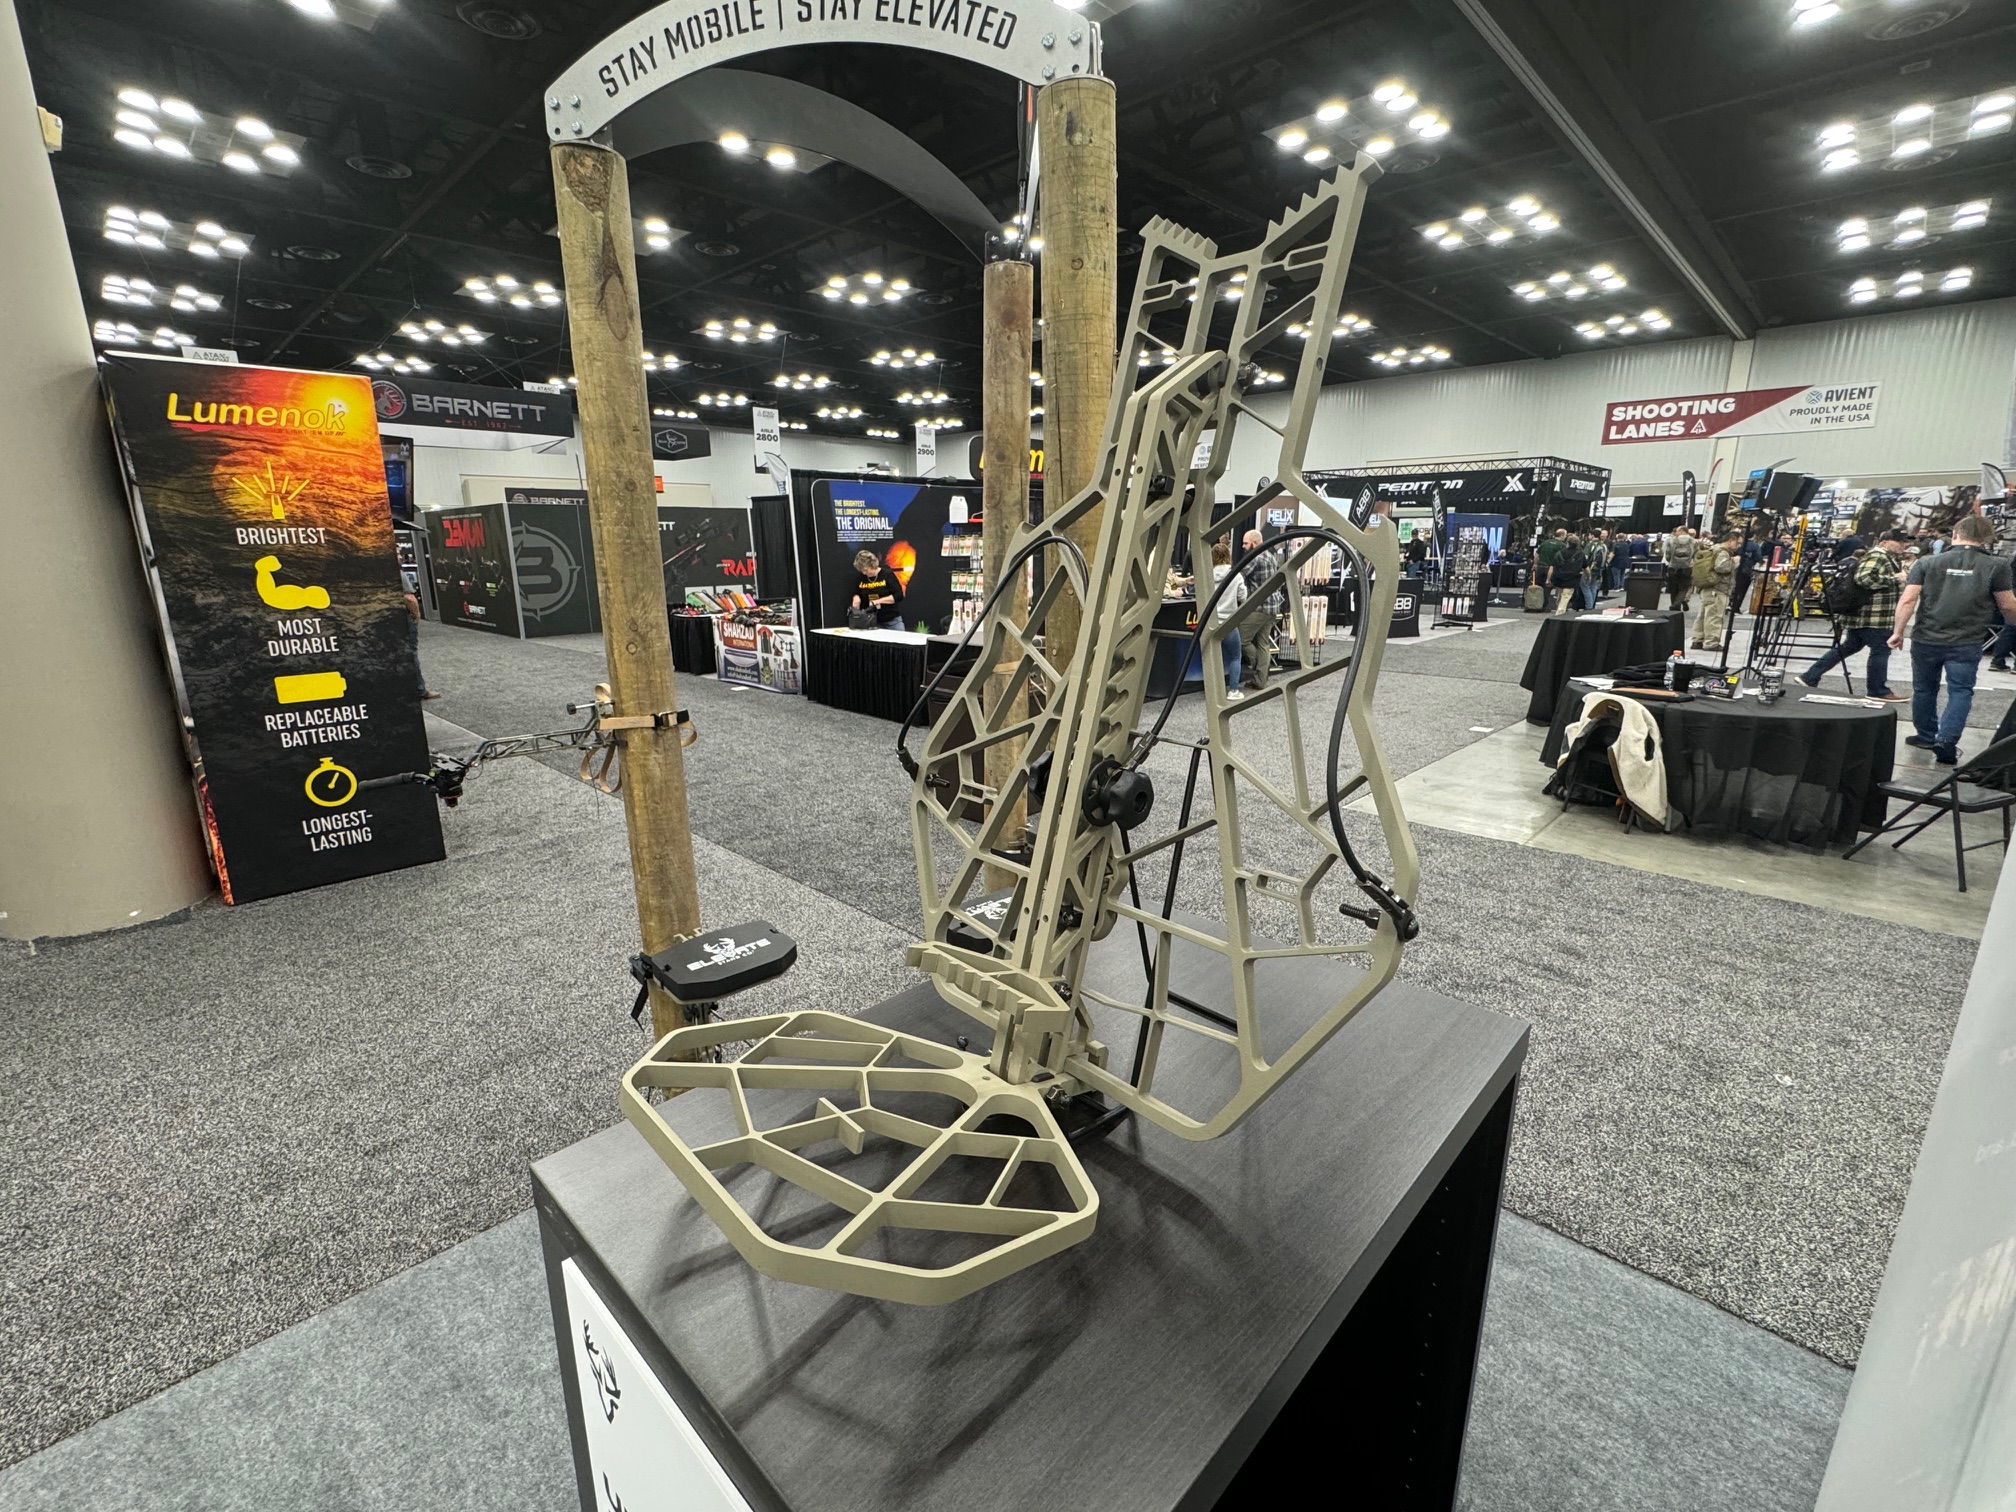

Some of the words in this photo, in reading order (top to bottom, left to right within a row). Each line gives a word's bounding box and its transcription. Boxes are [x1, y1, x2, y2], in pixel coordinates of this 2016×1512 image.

[598, 36, 658, 98] STAY
[663, 0, 765, 60] MOBILE
[1824, 386, 1878, 402] AVIENT
[166, 392, 346, 430] Lumenok
[411, 394, 546, 422] BARNETT
[1611, 397, 1736, 422] SHOOTING
[1789, 405, 1839, 416] PROUDLY
[1841, 403, 1873, 412] MADE
[1810, 416, 1822, 425] IN
[1824, 415, 1845, 424] THE
[1848, 413, 1870, 422] USA
[756, 433, 779, 442] 2800
[1609, 422, 1685, 440] LANES
[917, 448, 935, 456] 2900
[835, 516, 853, 530] THE
[854, 517, 893, 530] ORIGINAL.
[1268, 508, 1294, 521] HELIX
[236, 527, 326, 545] BRIGHTEST
[277, 618, 322, 637] MOST
[723, 622, 755, 640] SHAHZAD
[267, 636, 340, 657] DURABLE
[264, 703, 369, 731] REPLACEABLE
[280, 723, 361, 748] BATTERIES
[302, 809, 373, 836] LONGEST-
[310, 827, 373, 852] LASTING
